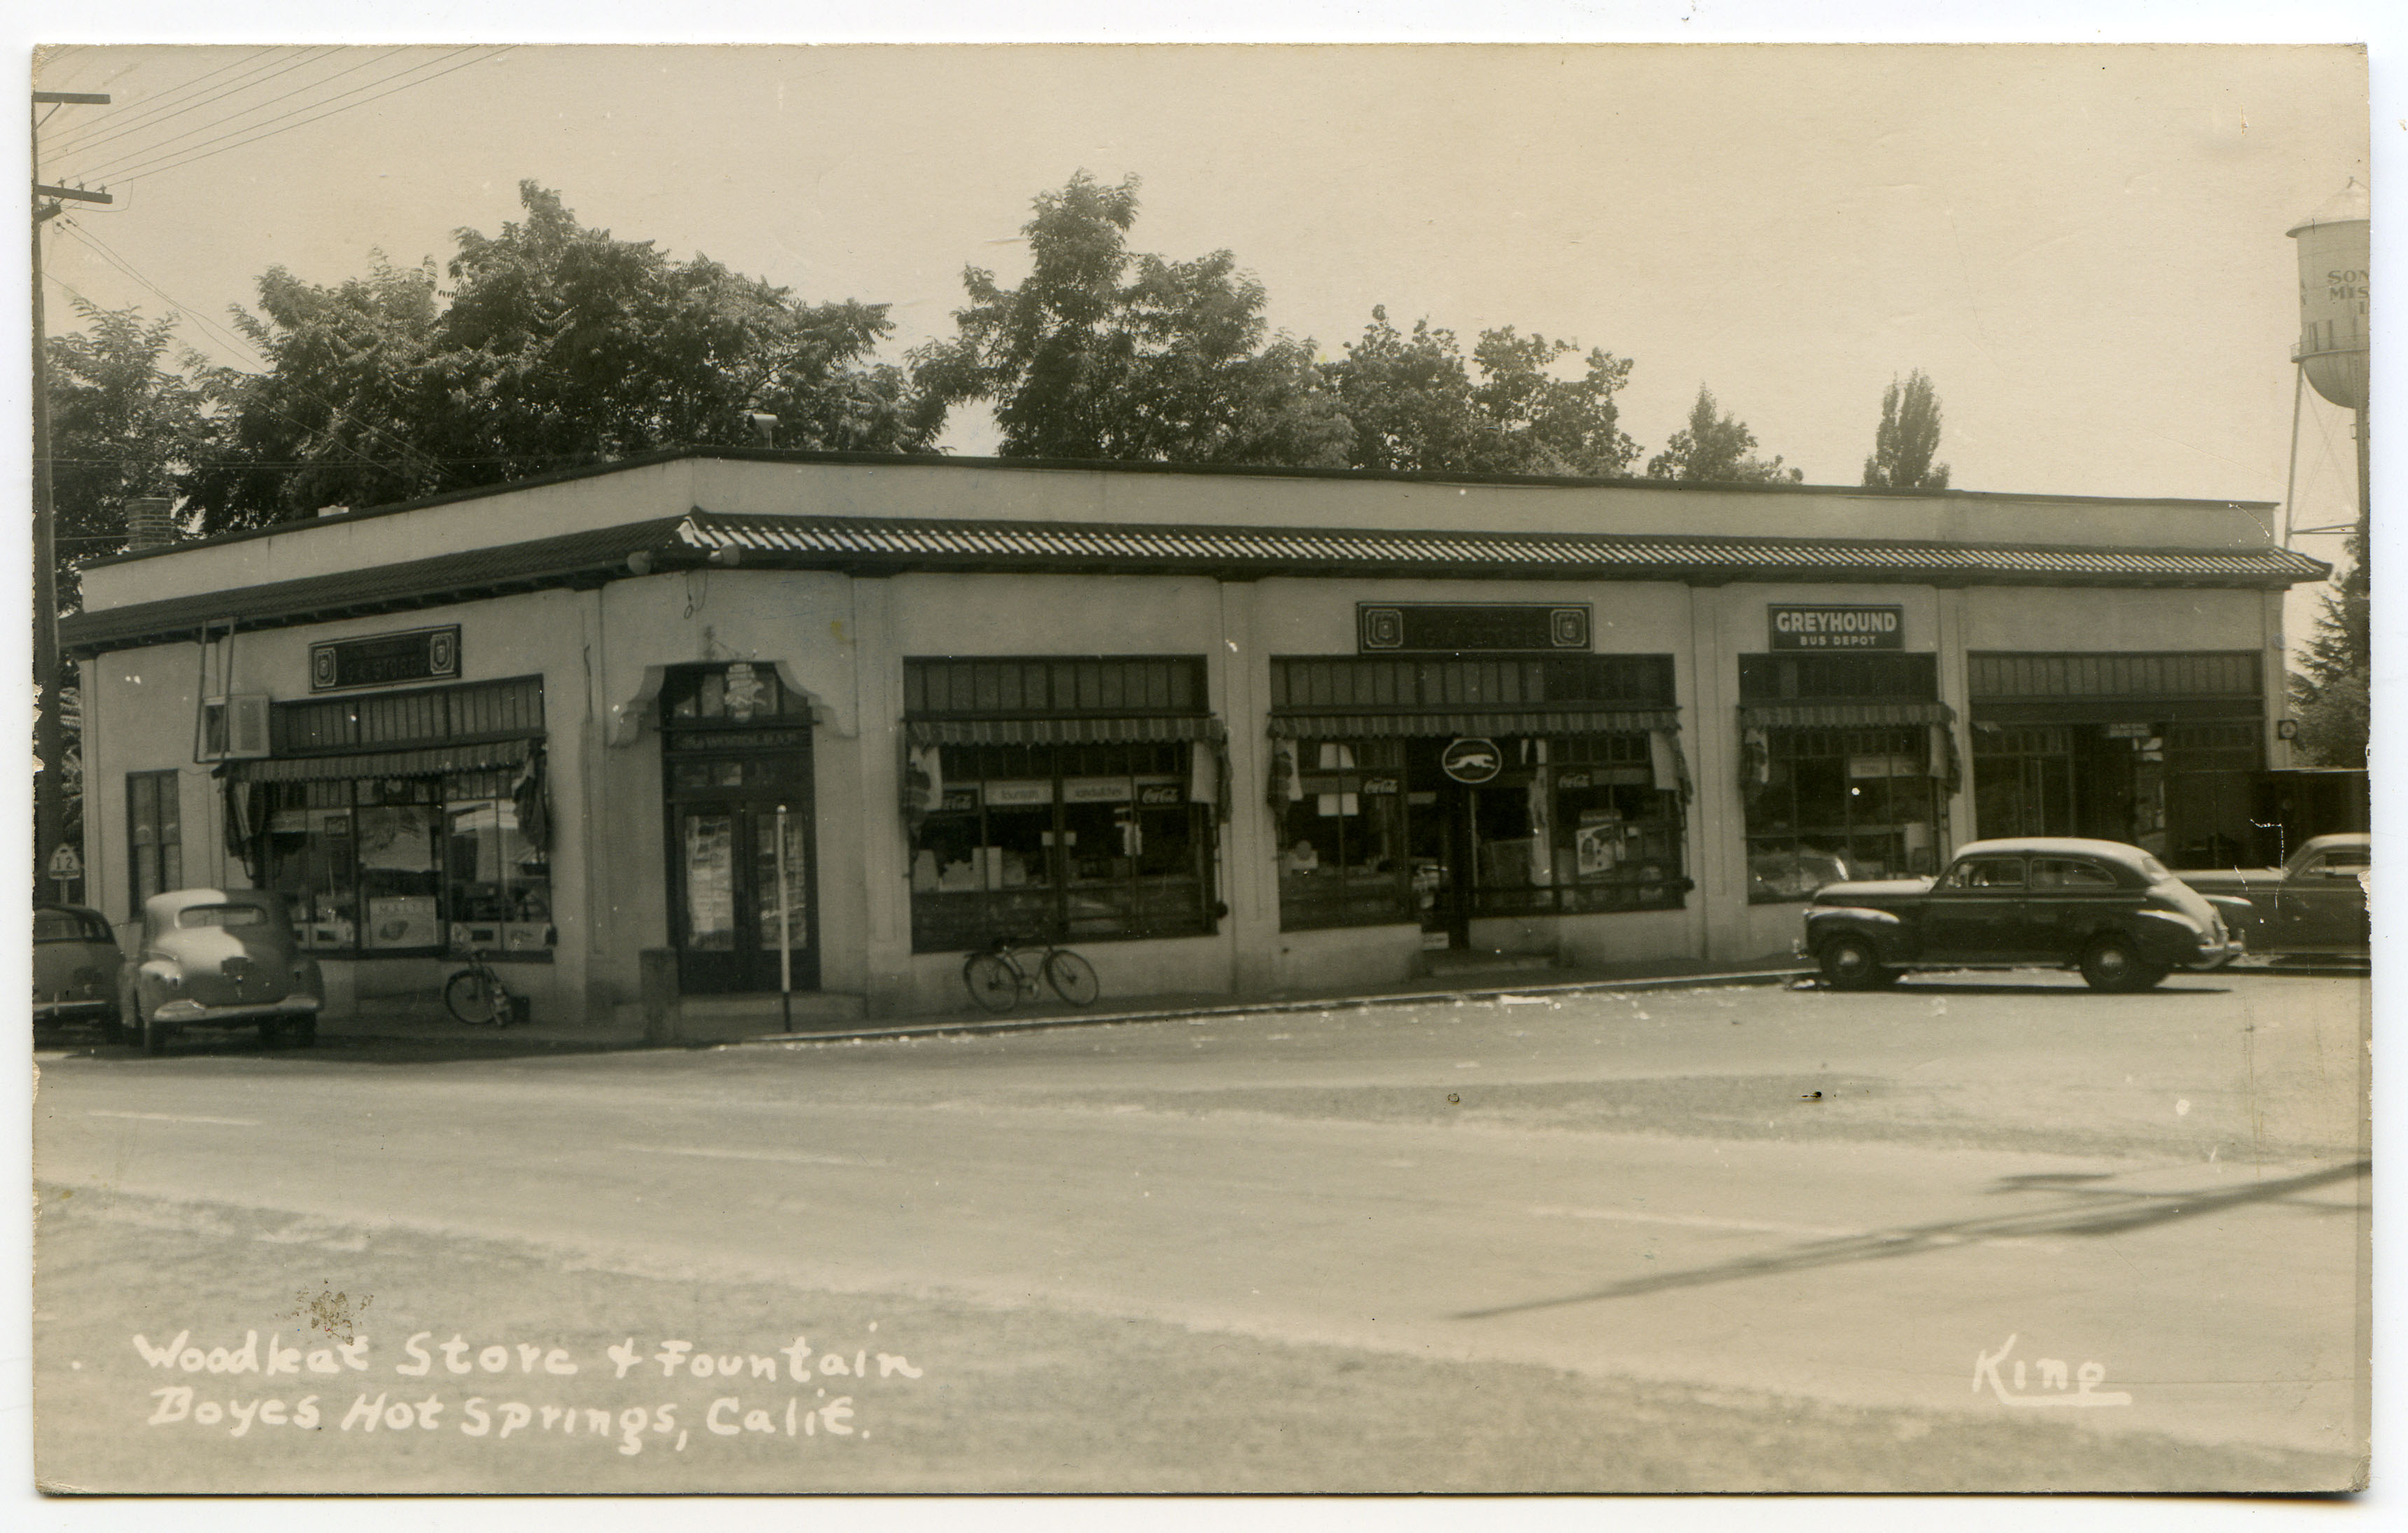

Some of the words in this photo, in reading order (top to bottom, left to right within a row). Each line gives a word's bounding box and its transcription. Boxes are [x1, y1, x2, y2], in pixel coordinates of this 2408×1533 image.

[1776, 611, 1897, 632] GREYHOUND
[1800, 635, 1827, 646] BUS
[1833, 635, 1877, 646] DEPOT
[1363, 779, 1398, 794] Coca-Cola
[55, 856, 74, 870] 12
